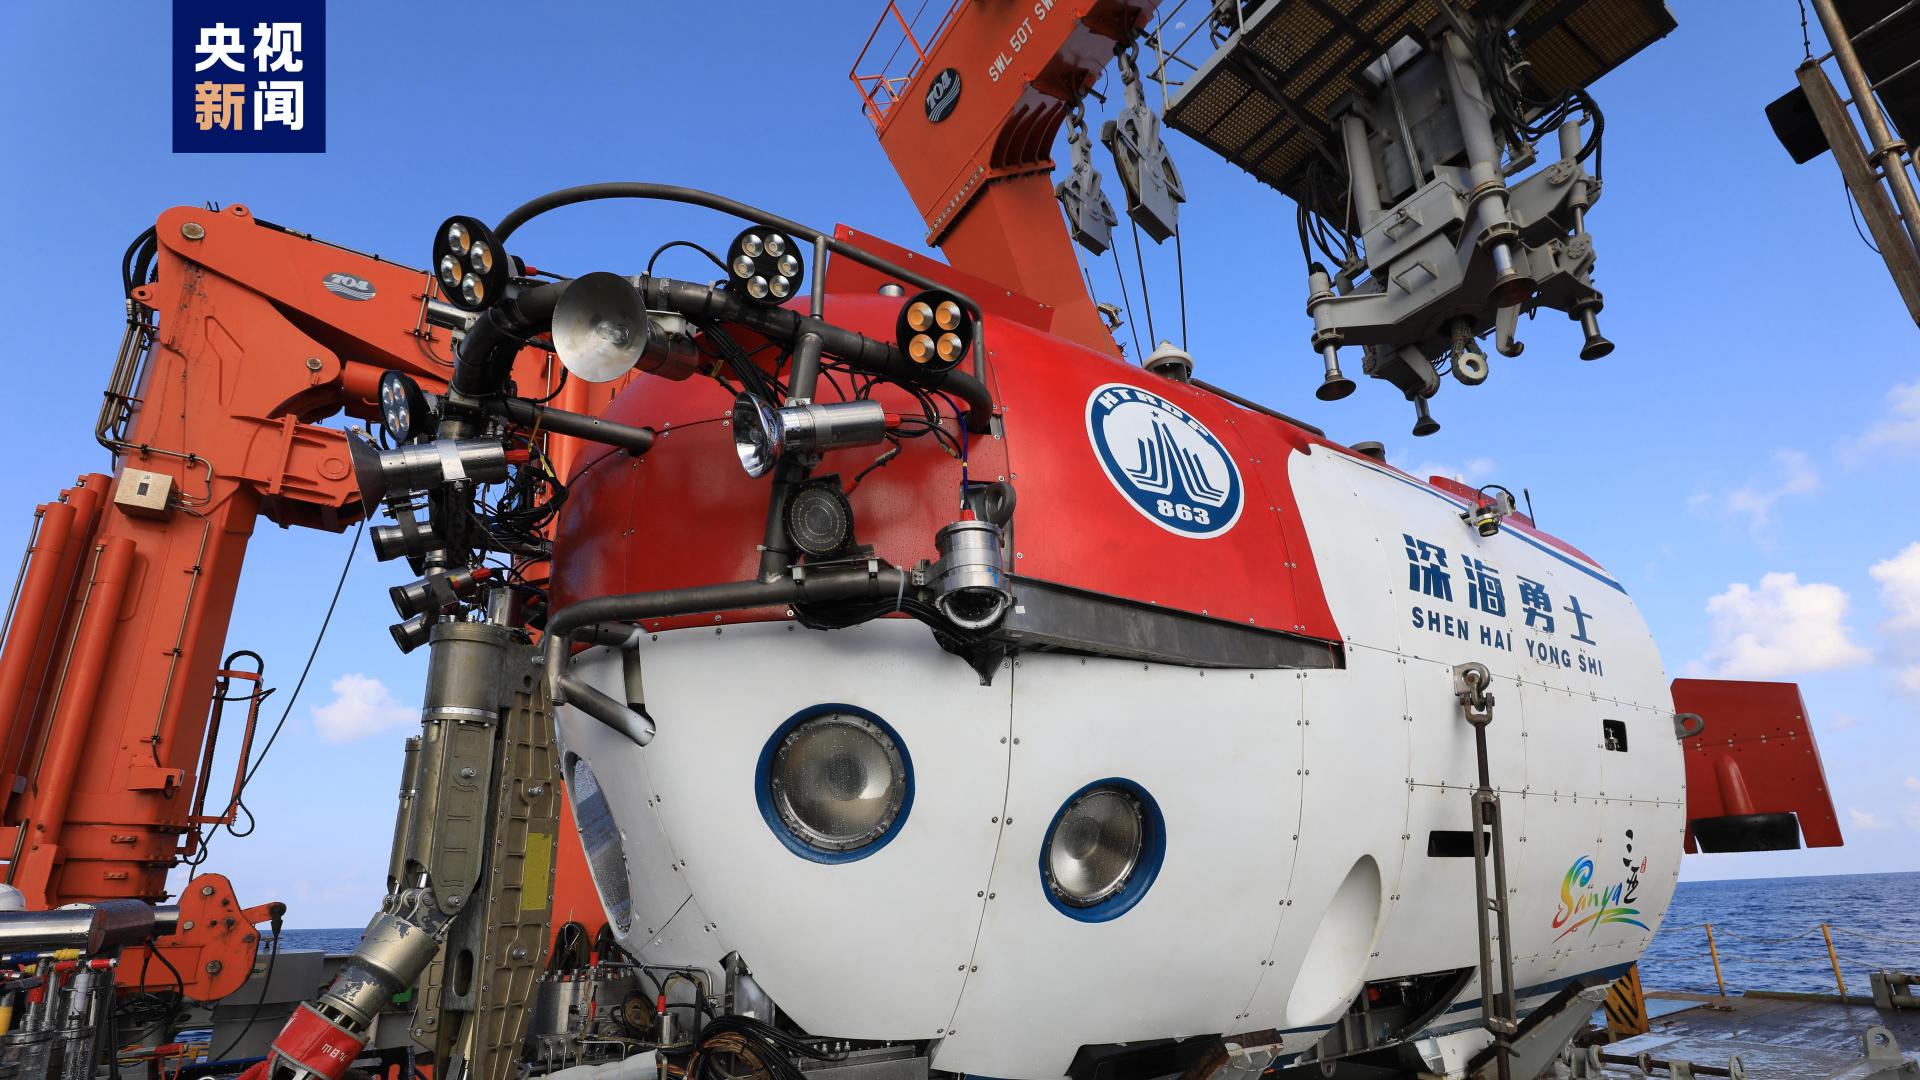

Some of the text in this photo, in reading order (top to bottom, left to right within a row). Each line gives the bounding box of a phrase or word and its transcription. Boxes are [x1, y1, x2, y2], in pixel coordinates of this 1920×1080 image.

[988, 0, 1054, 82] SWL 50T SW
[926, 70, 952, 110] 704
[1098, 389, 1209, 437] HTRDP
[1156, 500, 1210, 525] 863
[1402, 533, 1597, 646] 深海勇士
[1412, 606, 1604, 677] SHEN HAI YONG SHI
[1552, 855, 1623, 943] Sanya
